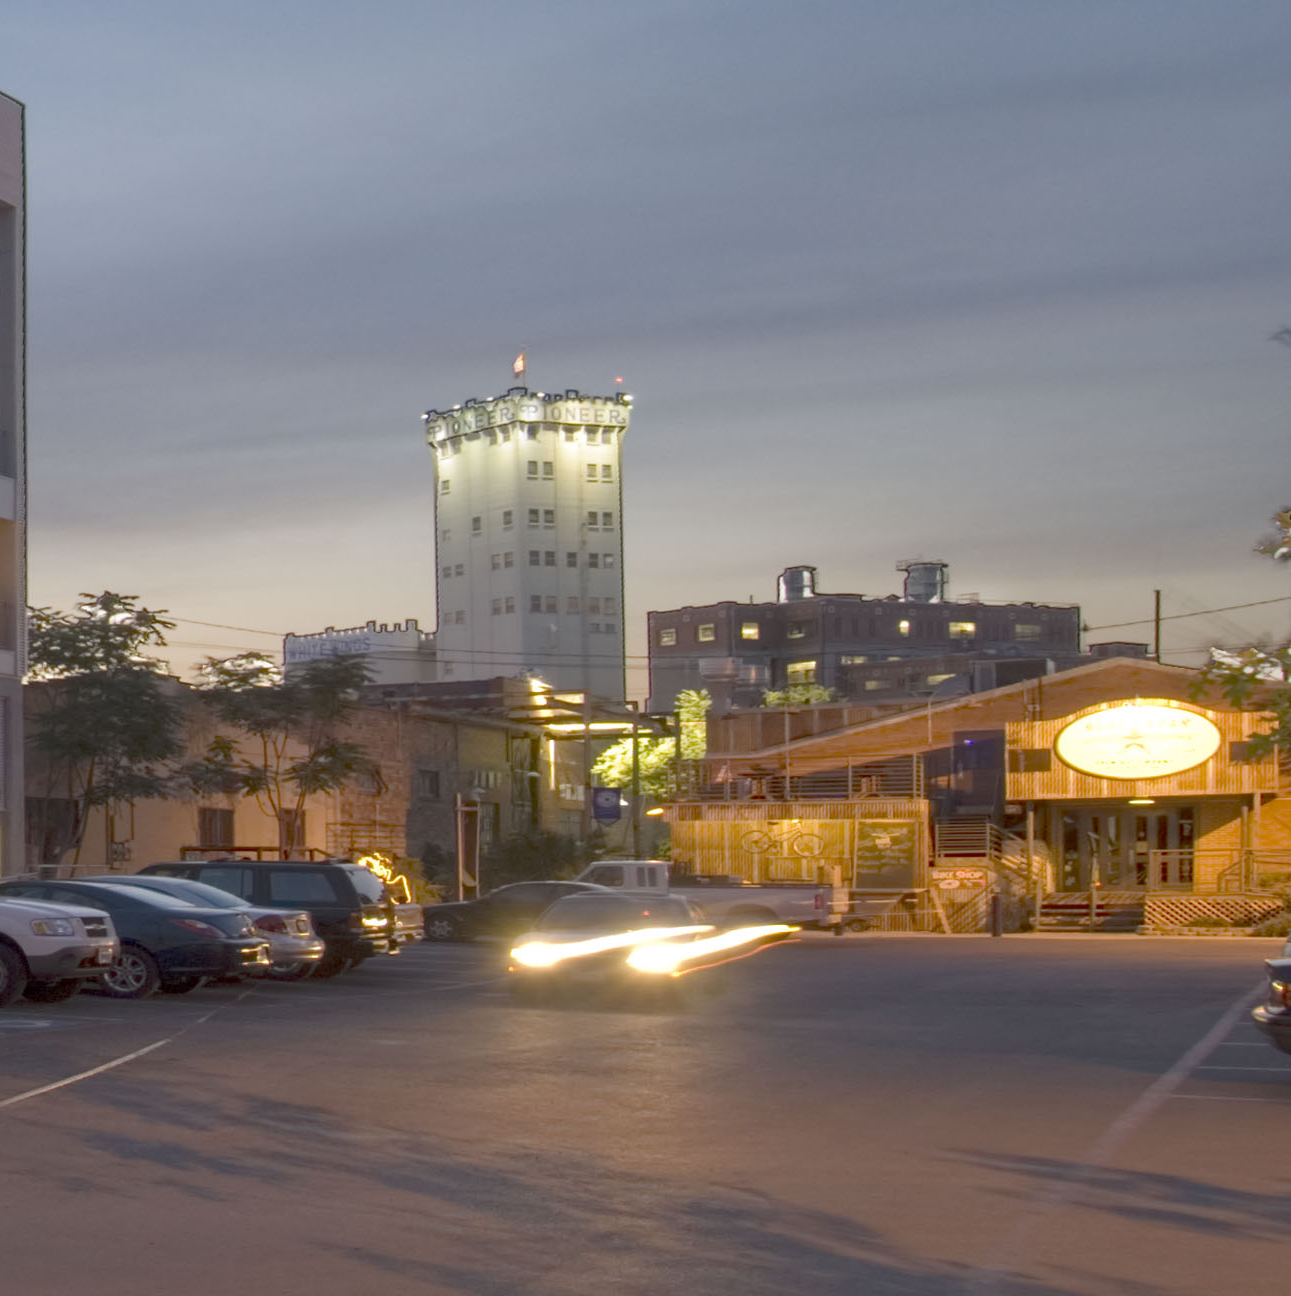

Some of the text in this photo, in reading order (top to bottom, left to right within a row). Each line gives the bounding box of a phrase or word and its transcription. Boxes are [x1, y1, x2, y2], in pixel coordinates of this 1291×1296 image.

[520, 405, 626, 423] PIONEER
[427, 407, 515, 439] PIONEER
[288, 643, 327, 660] WHITE
[932, 870, 985, 880] BIKE SHOP
